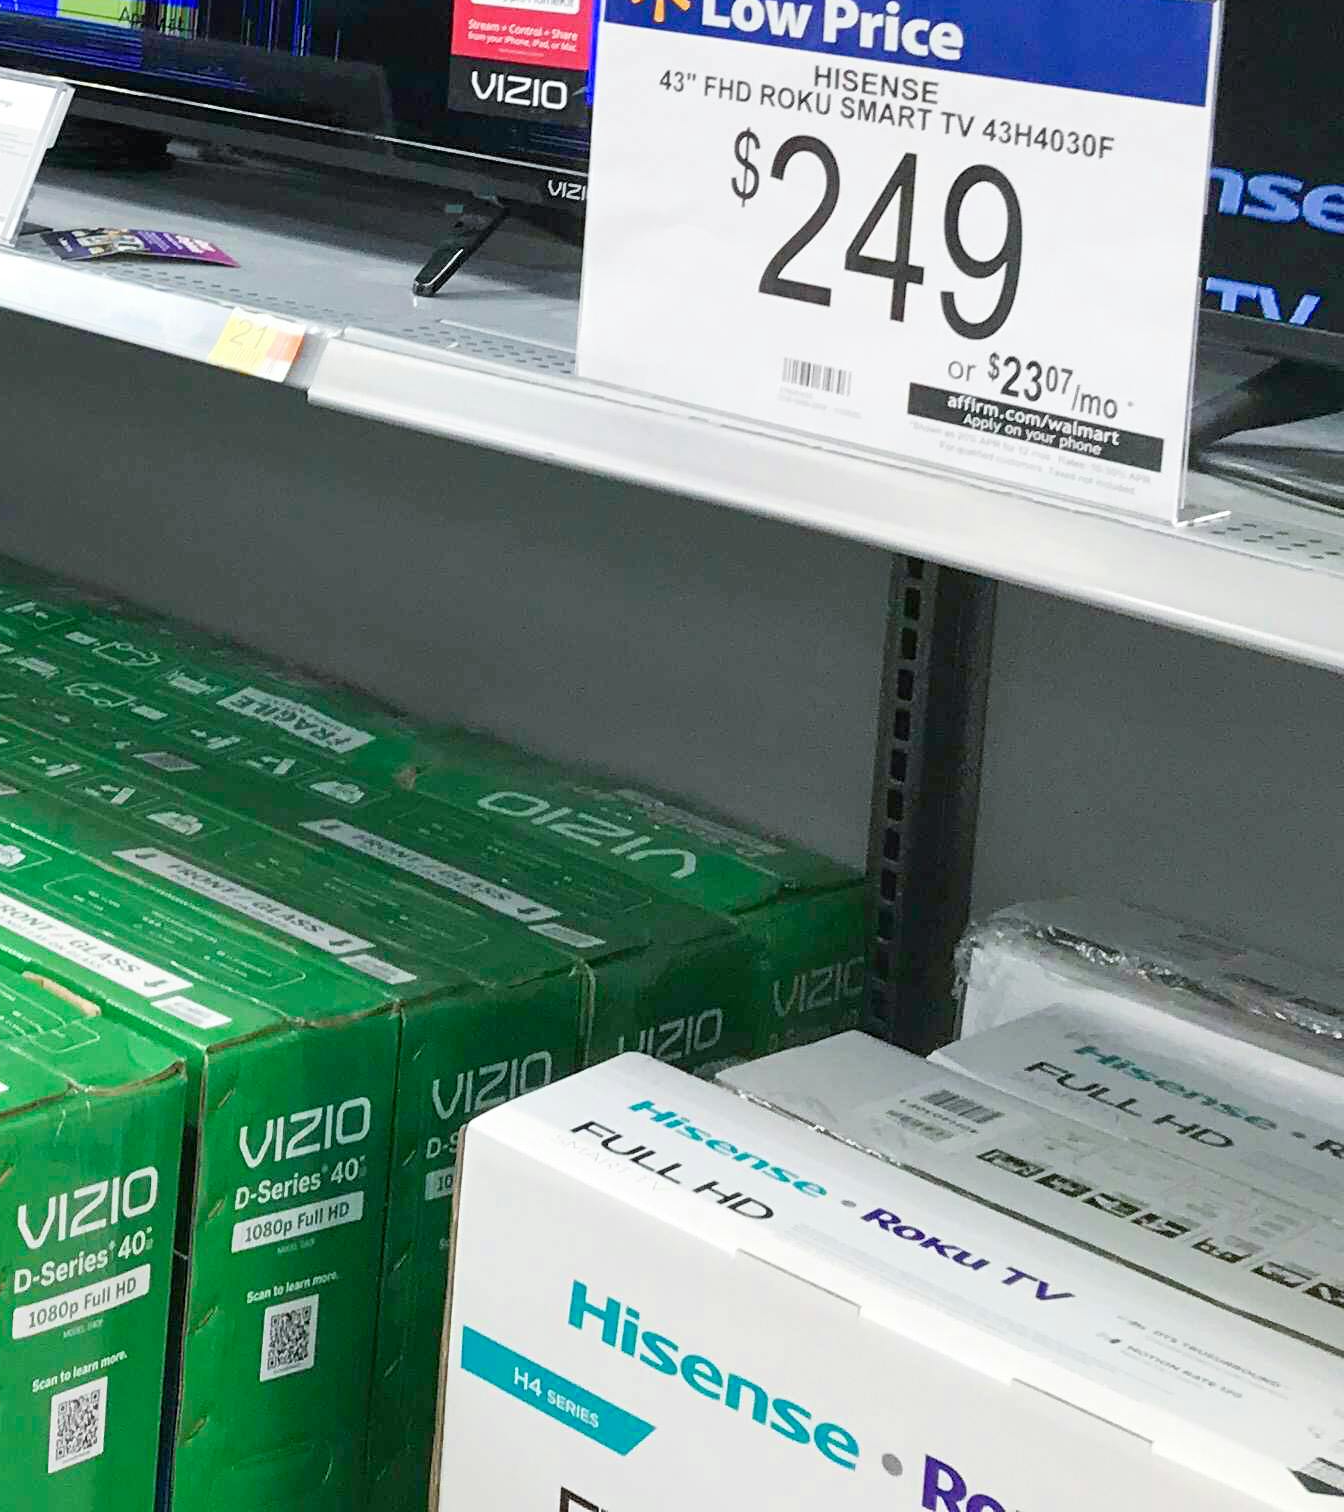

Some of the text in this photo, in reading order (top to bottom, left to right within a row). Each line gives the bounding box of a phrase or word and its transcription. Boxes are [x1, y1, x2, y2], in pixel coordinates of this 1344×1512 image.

[468, 18, 578, 42] Stream Control Share
[471, 70, 568, 110] VIZIO
[813, 65, 940, 105] HISENSE
[658, 70, 1116, 161] 43" FHD ROKU SMART TV 43H4030F
[731, 127, 1024, 341] $249
[229, 319, 266, 347] 21
[946, 393, 1121, 447] affirm.com/walmart
[962, 414, 1103, 456] Apply on your phone
[168, 859, 324, 934] FRONT GLASS
[68, 940, 141, 976] GLASS
[773, 957, 868, 1018] VIZIO
[430, 1049, 552, 1122] VIZIO
[1024, 1061, 1234, 1148] FULL HD
[1074, 1044, 1277, 1130] Hisense
[239, 1096, 372, 1170] VIZIO
[234, 1168, 328, 1210] D-Series
[569, 1119, 689, 1190] FULL
[702, 1182, 774, 1222] HD
[17, 1166, 159, 1250] VIZIO
[244, 1201, 350, 1243] 1080p Full HD
[627, 1099, 829, 1199] Hisense
[998, 1266, 1077, 1303] TV
[14, 1245, 115, 1295] D-Series
[246, 1272, 339, 1305] Scan to learn more.
[28, 1276, 137, 1330] 1080p Full HD
[32, 1352, 128, 1394] Scan to learn more.
[512, 1367, 600, 1431] H4 SERIES
[568, 1281, 860, 1472] Hisense
